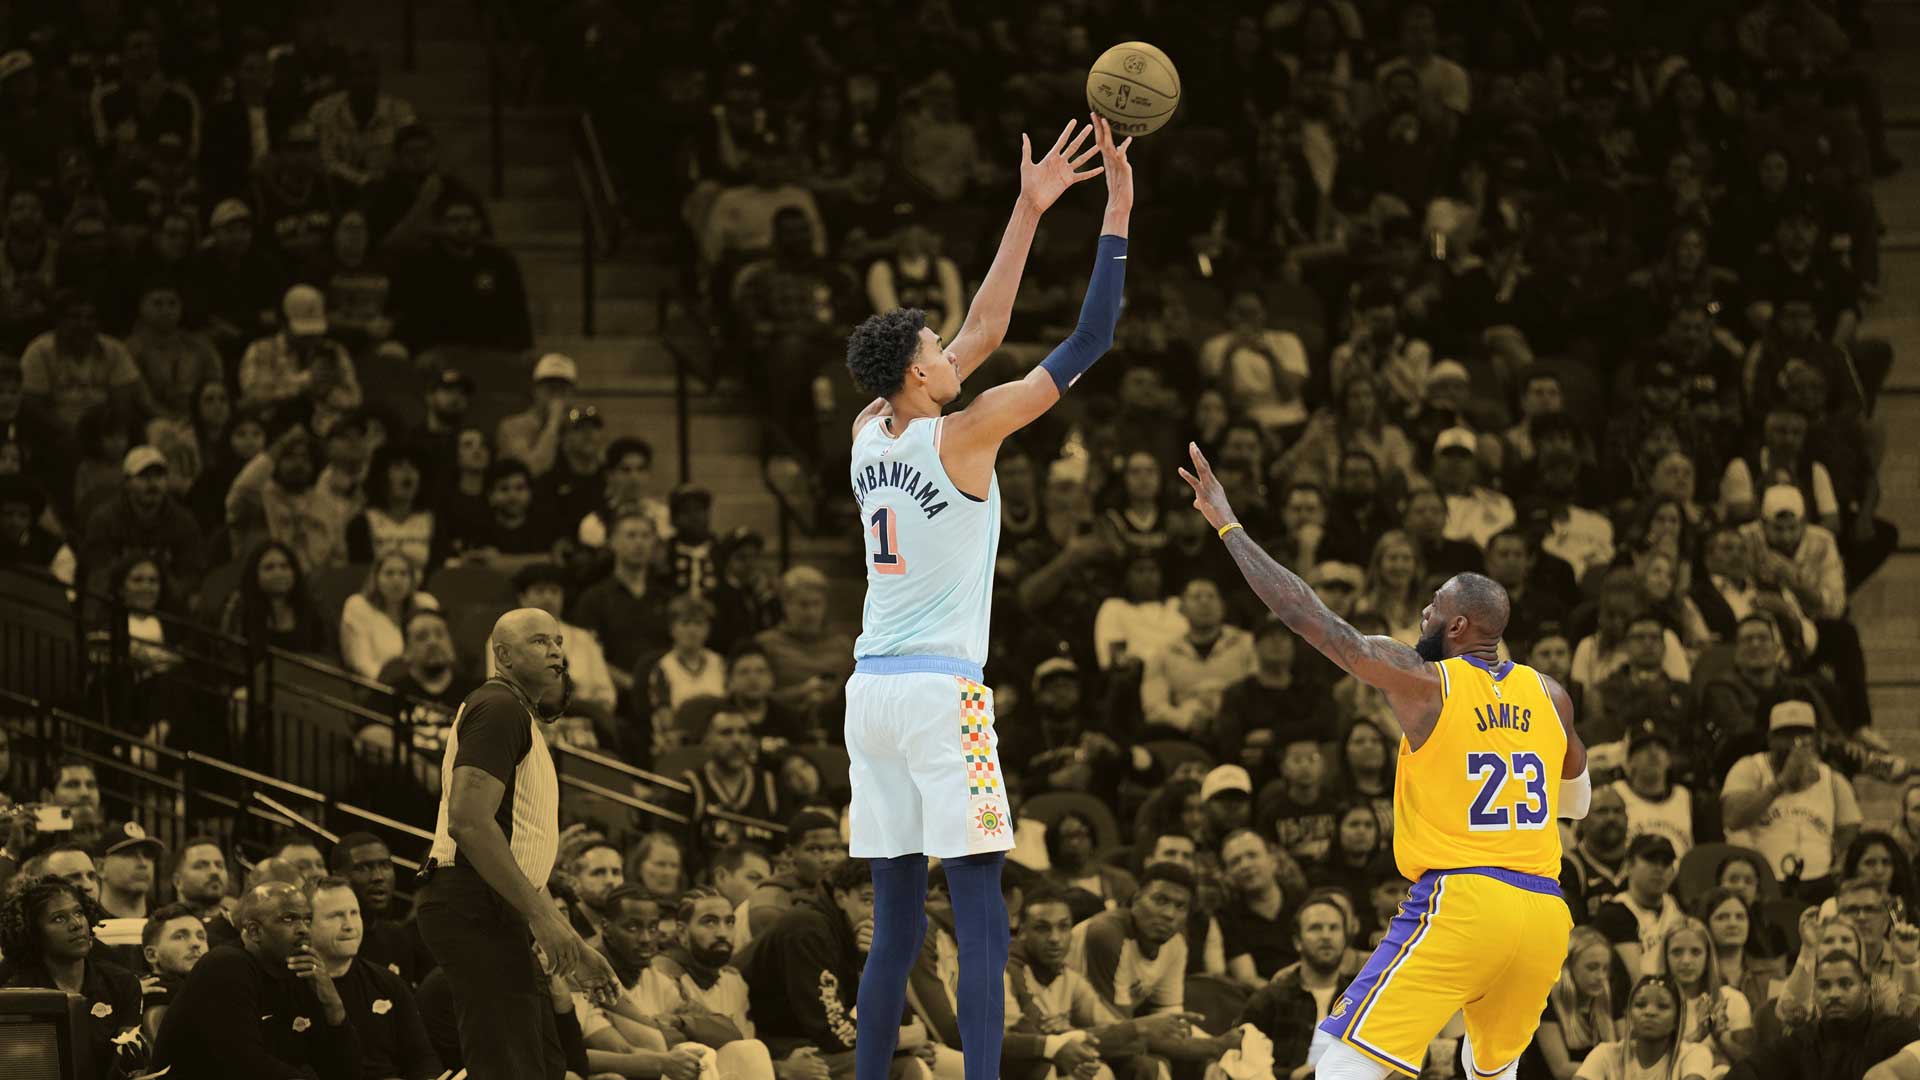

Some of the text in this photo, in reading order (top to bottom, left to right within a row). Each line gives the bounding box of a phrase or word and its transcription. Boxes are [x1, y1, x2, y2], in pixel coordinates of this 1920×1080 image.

[870, 507, 903, 570] 1
[1474, 703, 1531, 732] JAMES
[1467, 752, 1549, 831] 23
